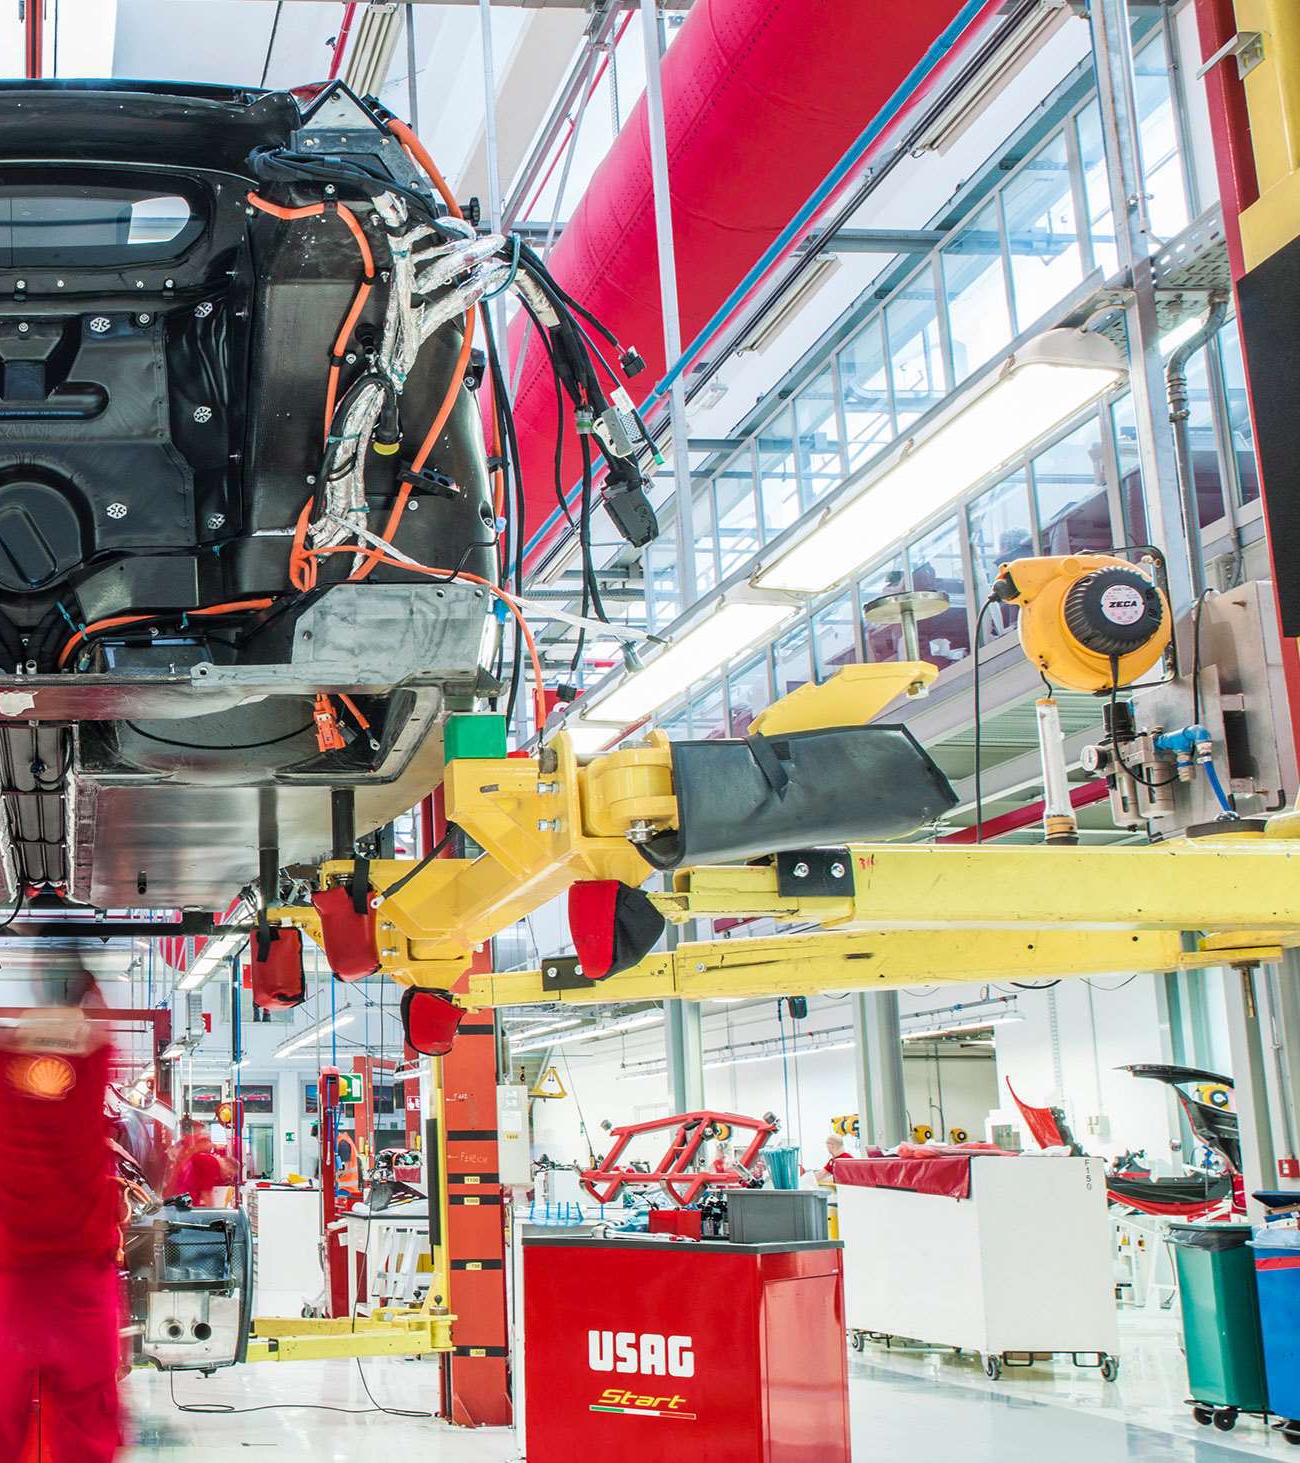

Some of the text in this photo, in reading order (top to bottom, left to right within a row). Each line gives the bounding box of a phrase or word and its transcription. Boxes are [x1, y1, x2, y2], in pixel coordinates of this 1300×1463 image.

[1108, 600, 1138, 608] ZECA
[1084, 1159, 1093, 1191] F150
[588, 1330, 695, 1378] USAG
[598, 1389, 687, 1409] Start
